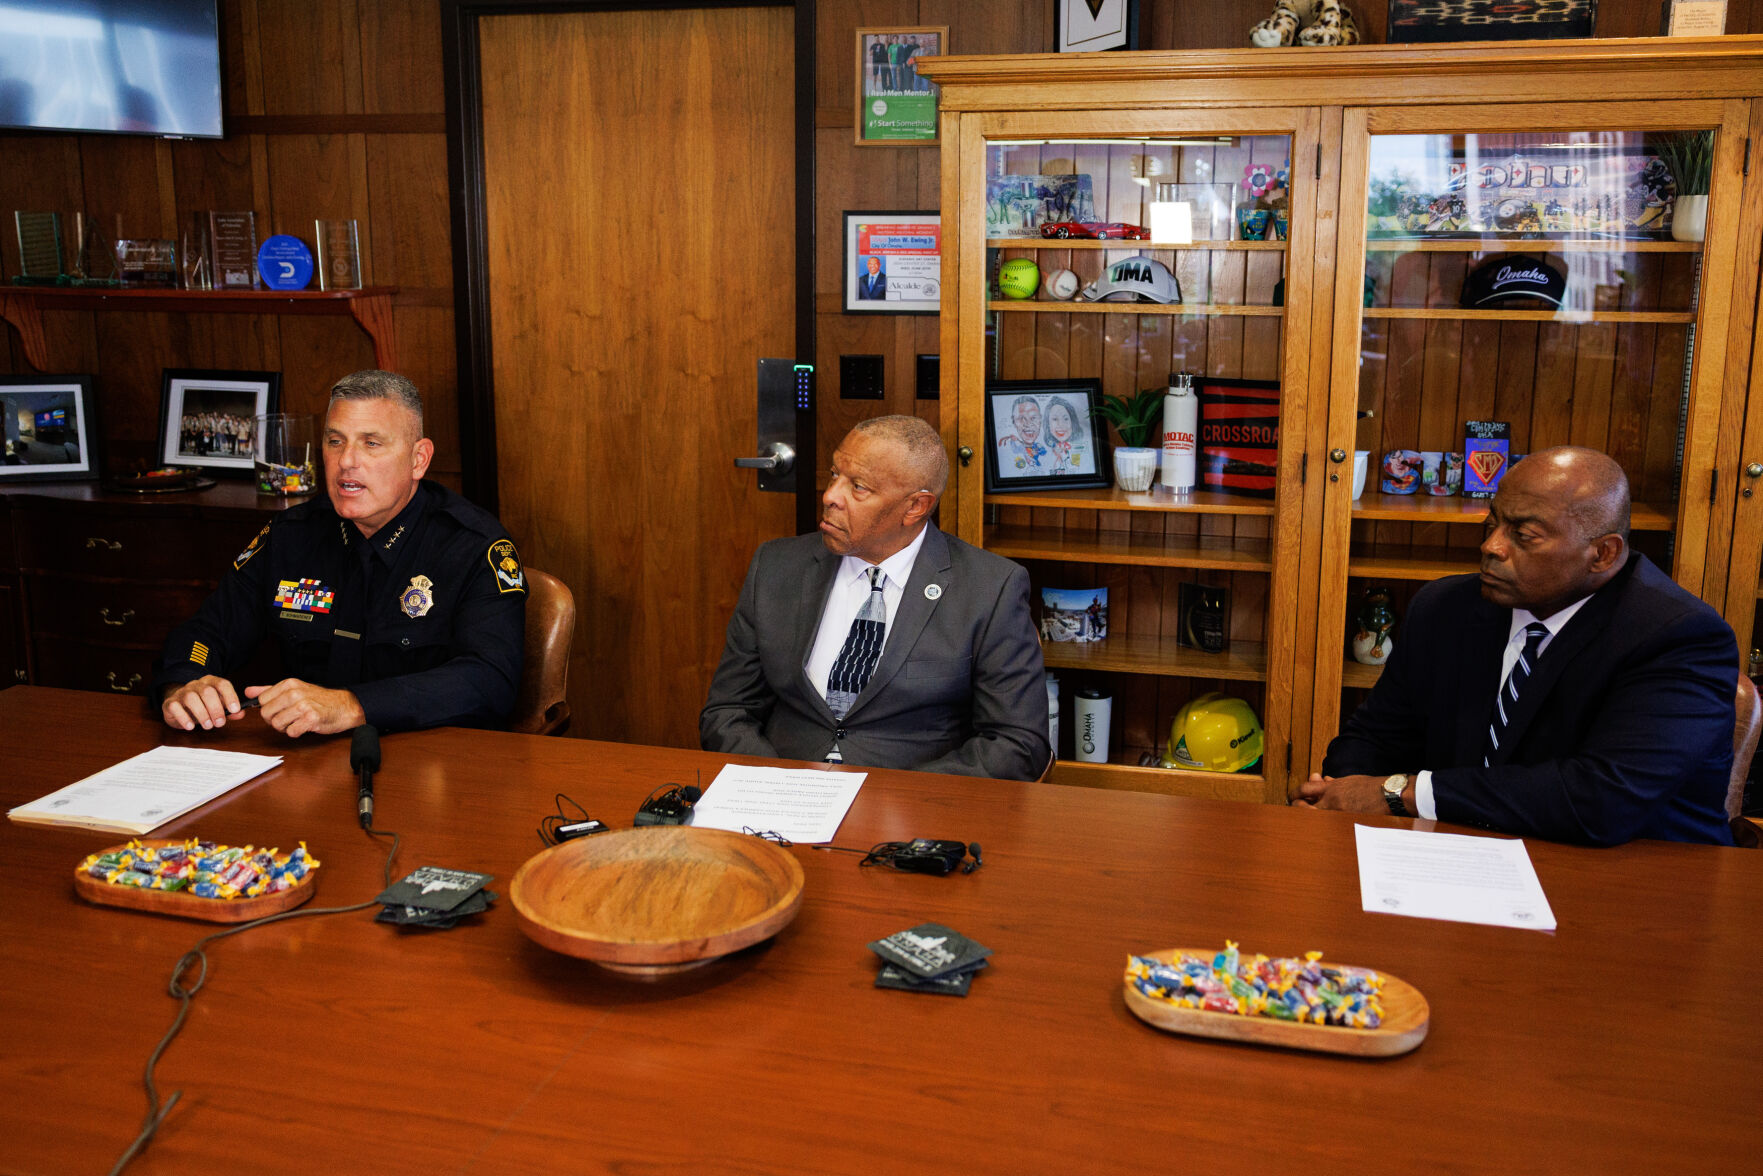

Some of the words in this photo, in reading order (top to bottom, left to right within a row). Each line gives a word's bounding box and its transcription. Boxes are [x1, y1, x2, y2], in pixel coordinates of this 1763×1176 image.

[896, 120, 934, 128] Something
[1495, 265, 1548, 284] Omaha
[1163, 431, 1194, 443] MOTAC
[1083, 713, 1092, 742] OMAHA
